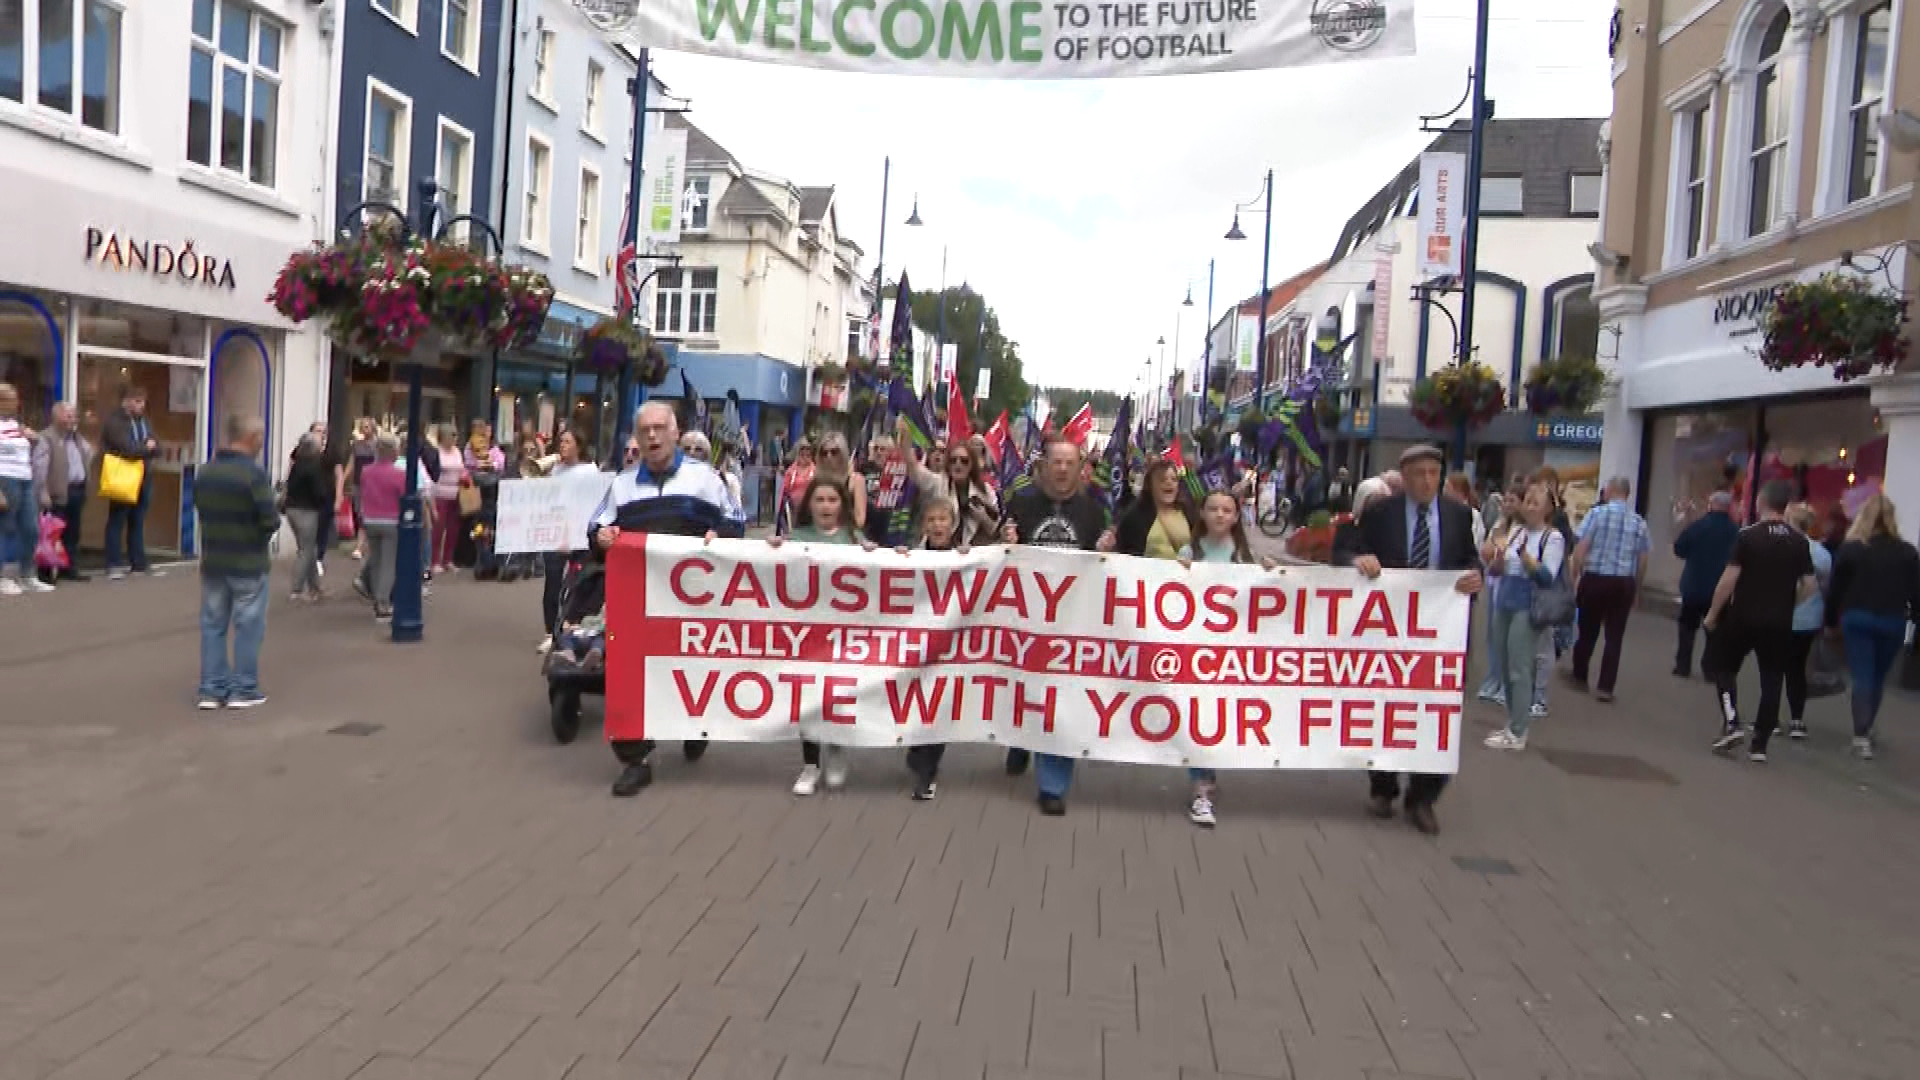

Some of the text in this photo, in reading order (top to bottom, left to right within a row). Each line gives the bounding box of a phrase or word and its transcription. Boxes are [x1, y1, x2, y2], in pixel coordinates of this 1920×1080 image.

[696, 0, 1043, 63] WELCOME
[1054, 0, 1257, 28] TO THE FUTURE
[1054, 32, 1233, 60] OF FOOTBALL
[86, 226, 236, 289] PANDORA
[670, 557, 1438, 639] CAUSEWAY HOSPITAL
[680, 622, 1462, 689] RALLY 15TH JULY 2PM @ CAUSEWAY H
[672, 669, 1461, 751] VOTE WITH YOUR FEET
